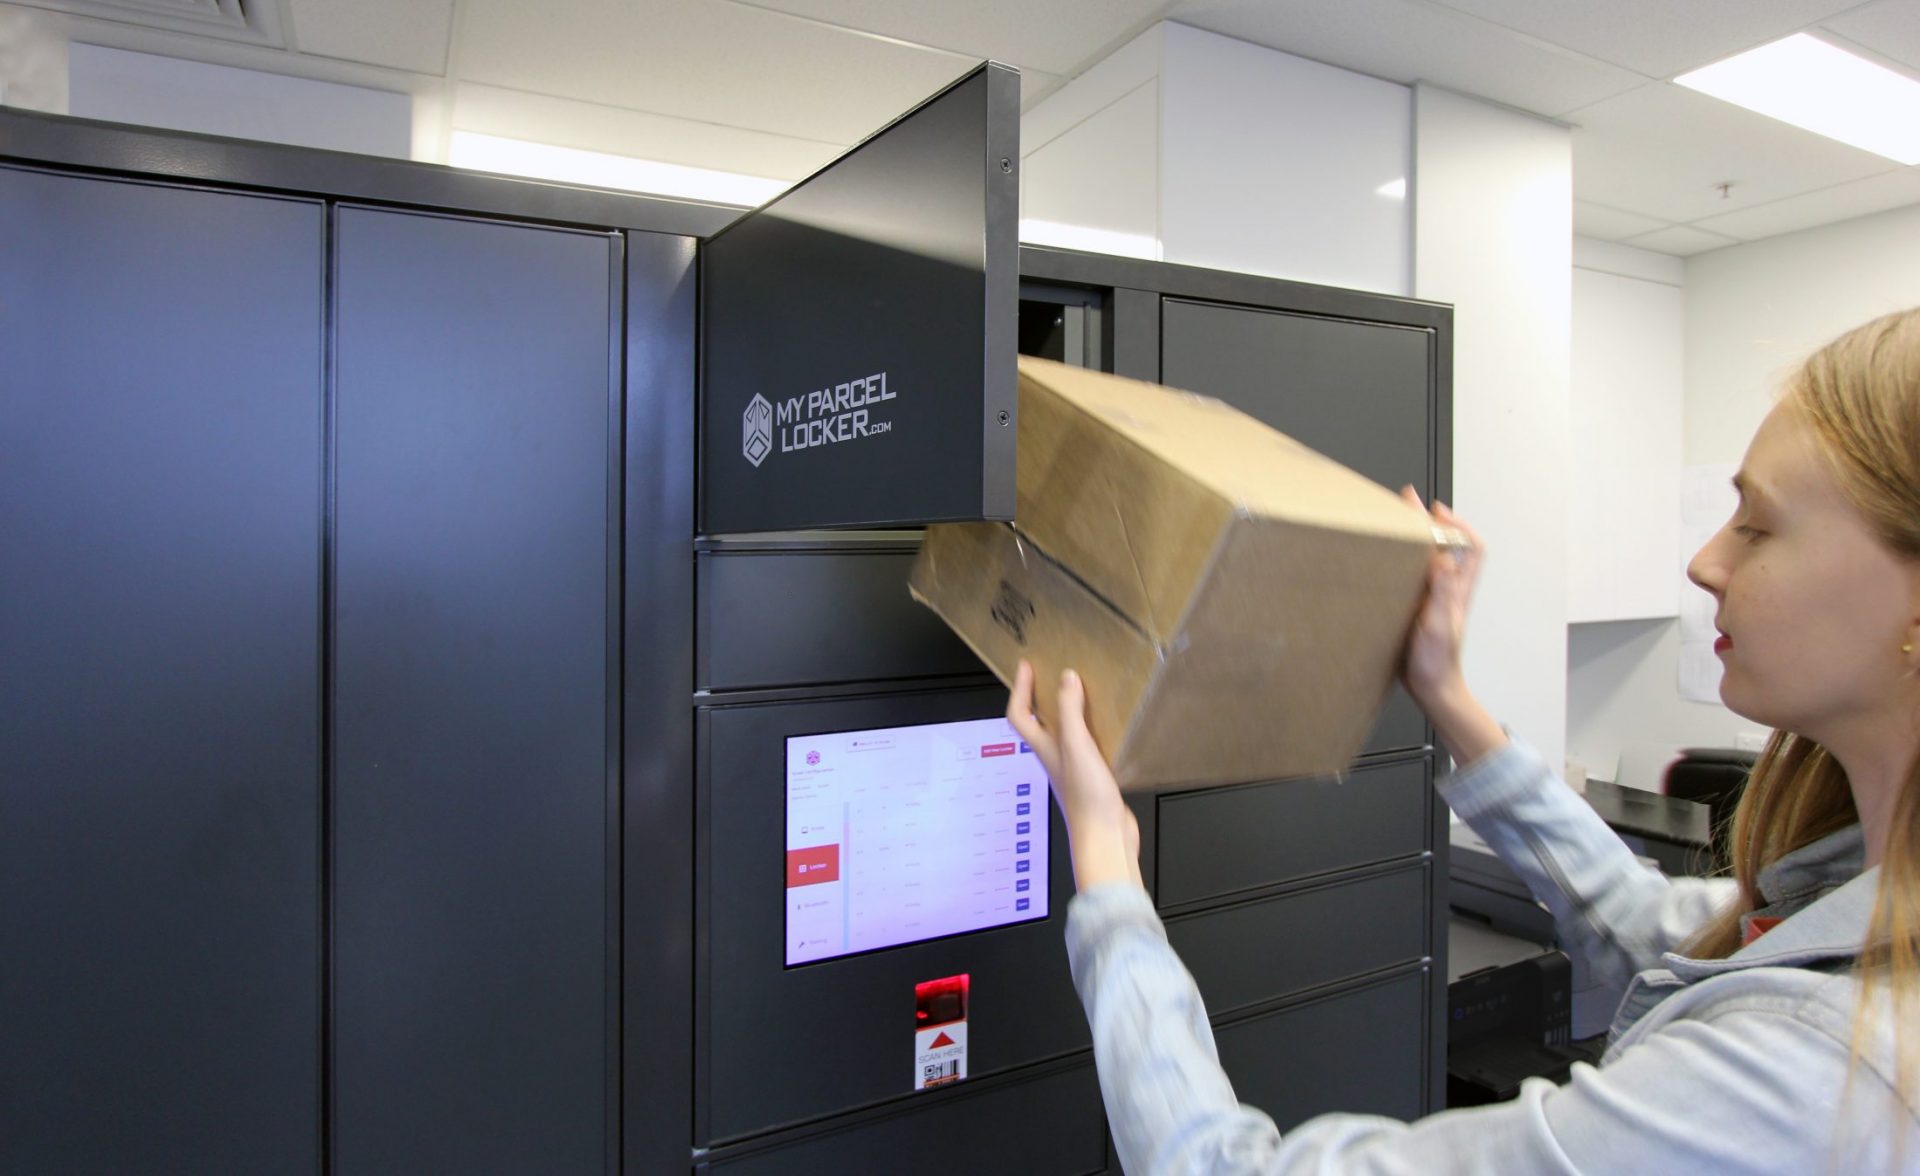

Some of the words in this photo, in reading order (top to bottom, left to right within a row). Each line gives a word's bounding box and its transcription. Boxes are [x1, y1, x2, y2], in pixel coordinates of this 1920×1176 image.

[776, 394, 806, 427] MY
[808, 371, 897, 419] PARCEL
[918, 1052, 941, 1064] SCAN
[943, 1046, 964, 1057] HERE
